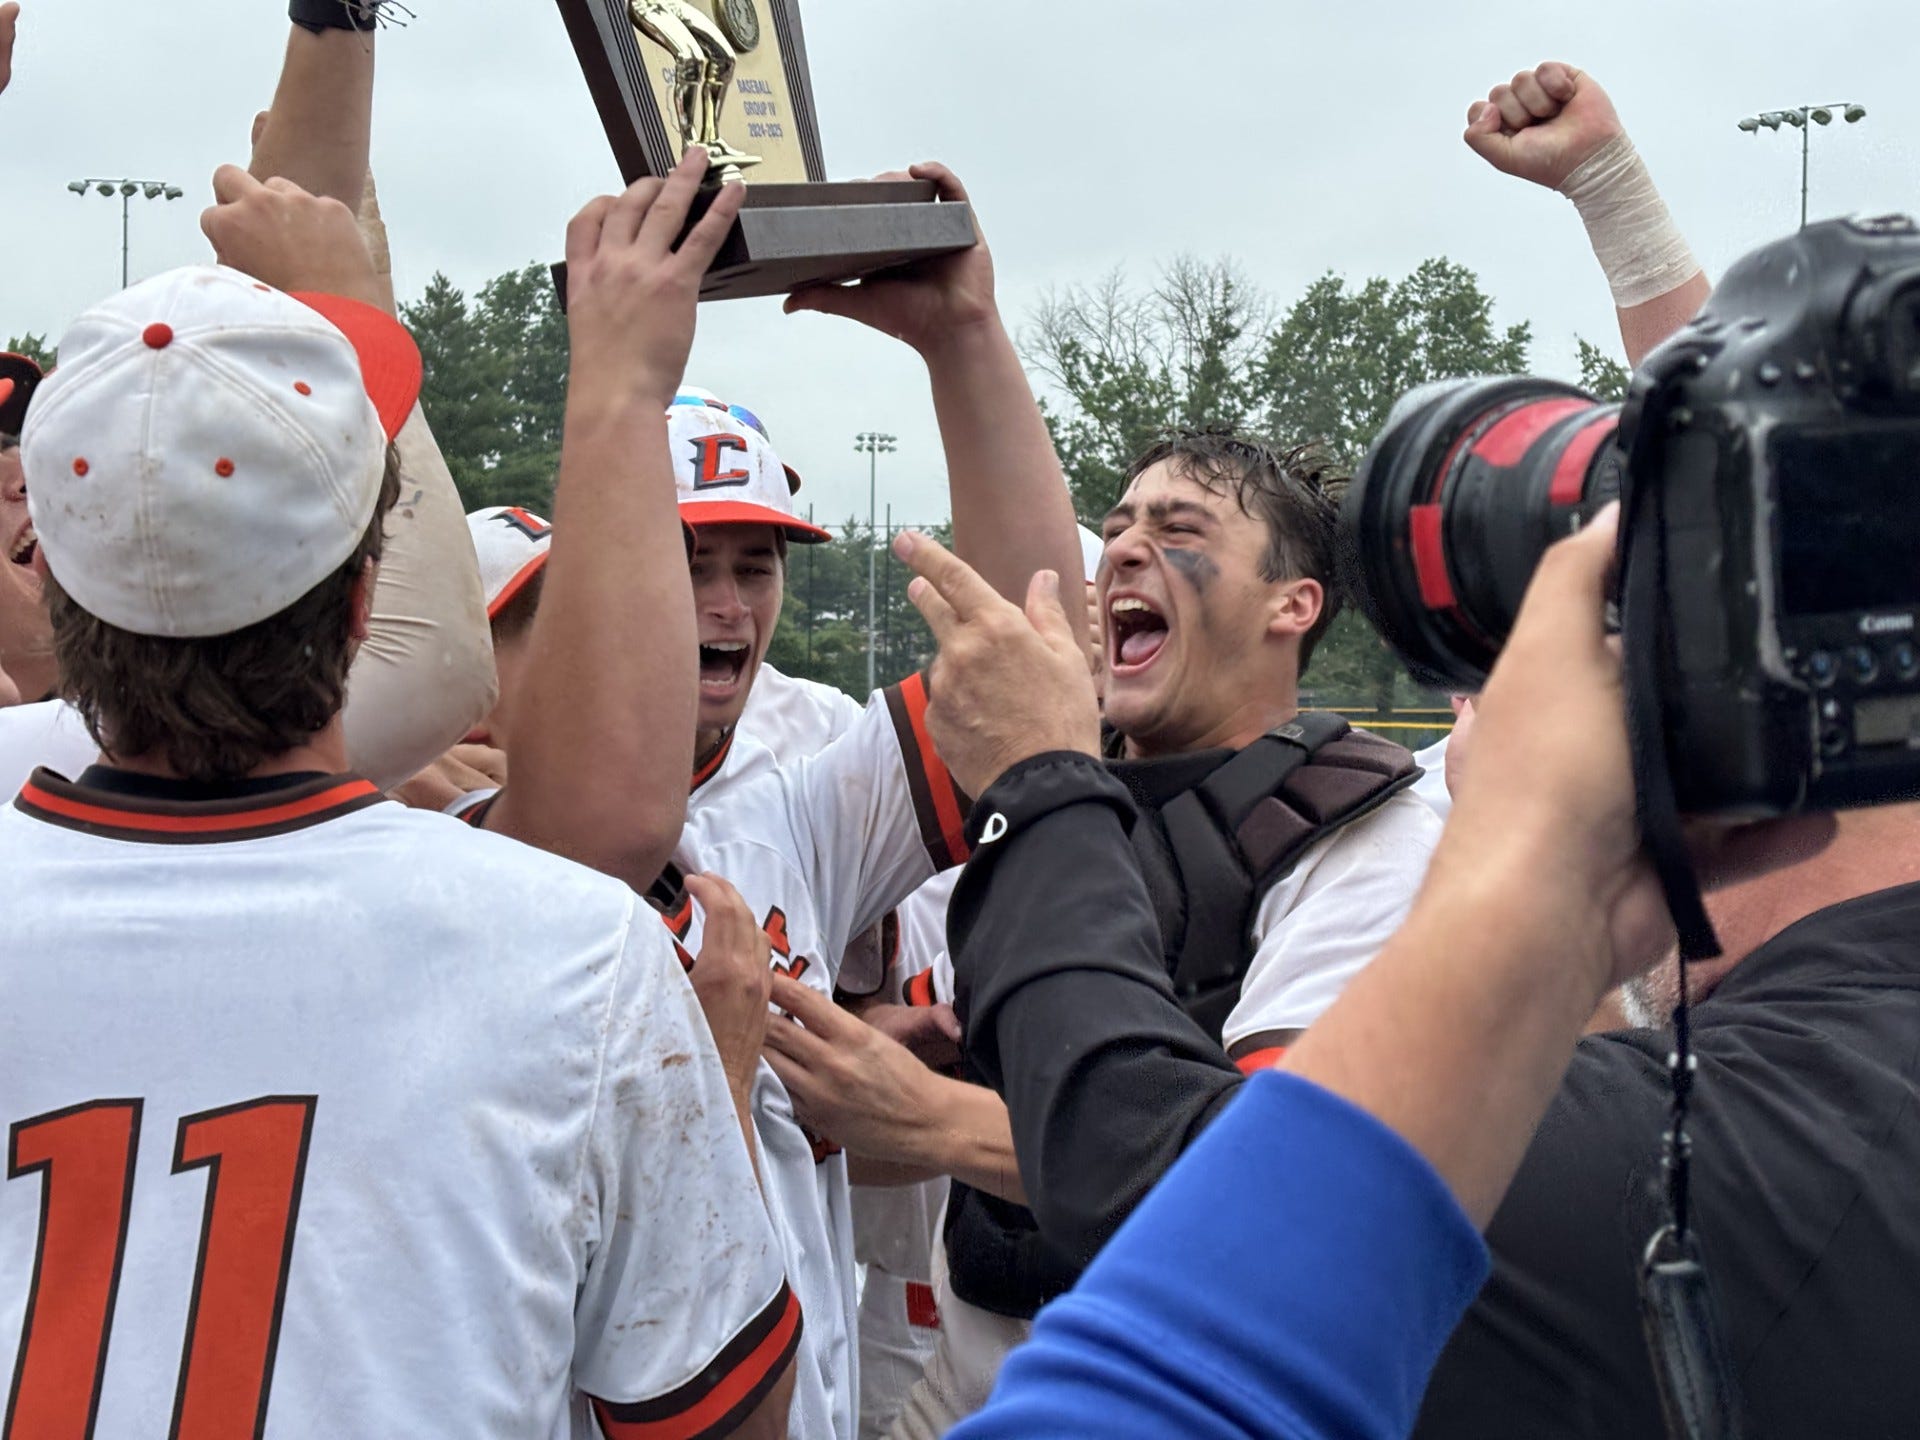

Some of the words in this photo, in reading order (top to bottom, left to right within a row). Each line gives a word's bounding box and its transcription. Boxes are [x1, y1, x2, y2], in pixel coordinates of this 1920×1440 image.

[736, 79, 771, 94] BASEBALL
[743, 101, 768, 116] GROUP
[749, 123, 783, 137] 2024-2025
[688, 433, 750, 491] C
[1860, 614, 1914, 633] Canon
[7, 1094, 319, 1440] 11
